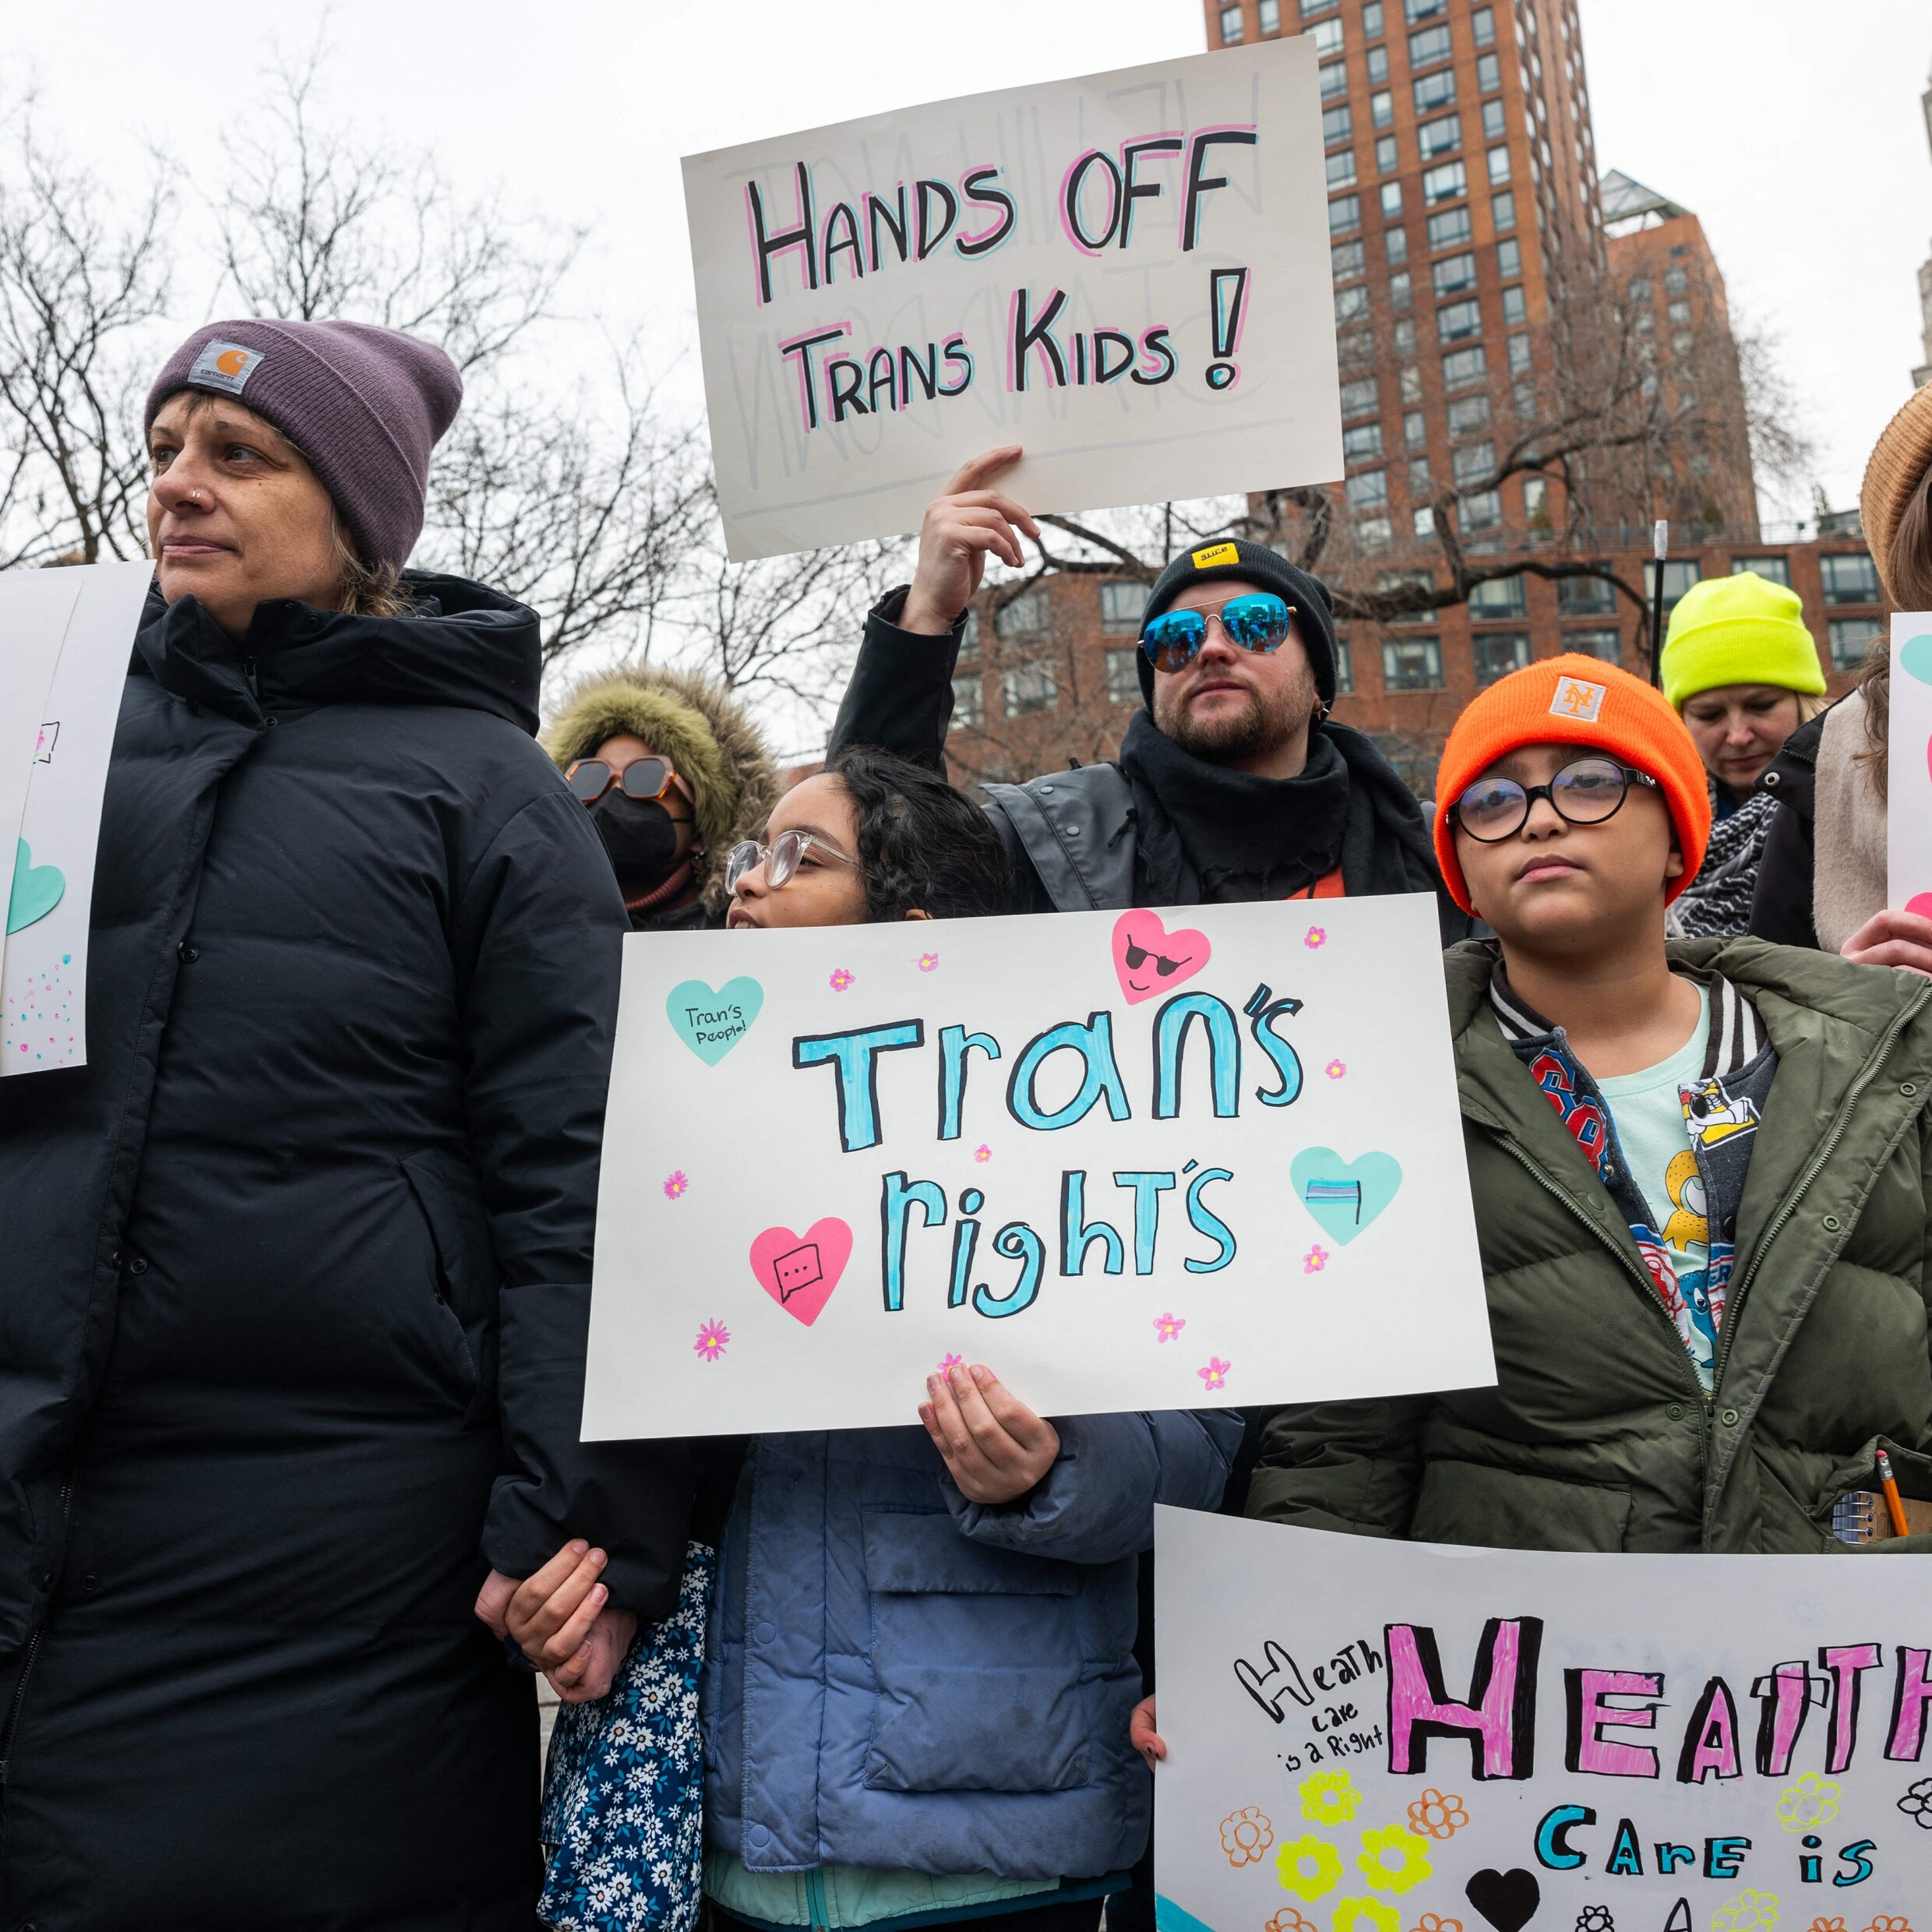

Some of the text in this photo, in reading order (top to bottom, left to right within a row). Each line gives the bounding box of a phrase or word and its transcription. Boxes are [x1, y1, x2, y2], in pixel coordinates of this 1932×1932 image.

[745, 124, 1259, 307] HANDS OFF
[779, 322, 975, 432] TRANS
[1008, 287, 1177, 395] KIDS
[685, 1004, 742, 1028] Tran's
[792, 983, 1304, 1154] Tran's
[1304, 1742, 1324, 1763] a
[1327, 1724, 1383, 1757] Right
